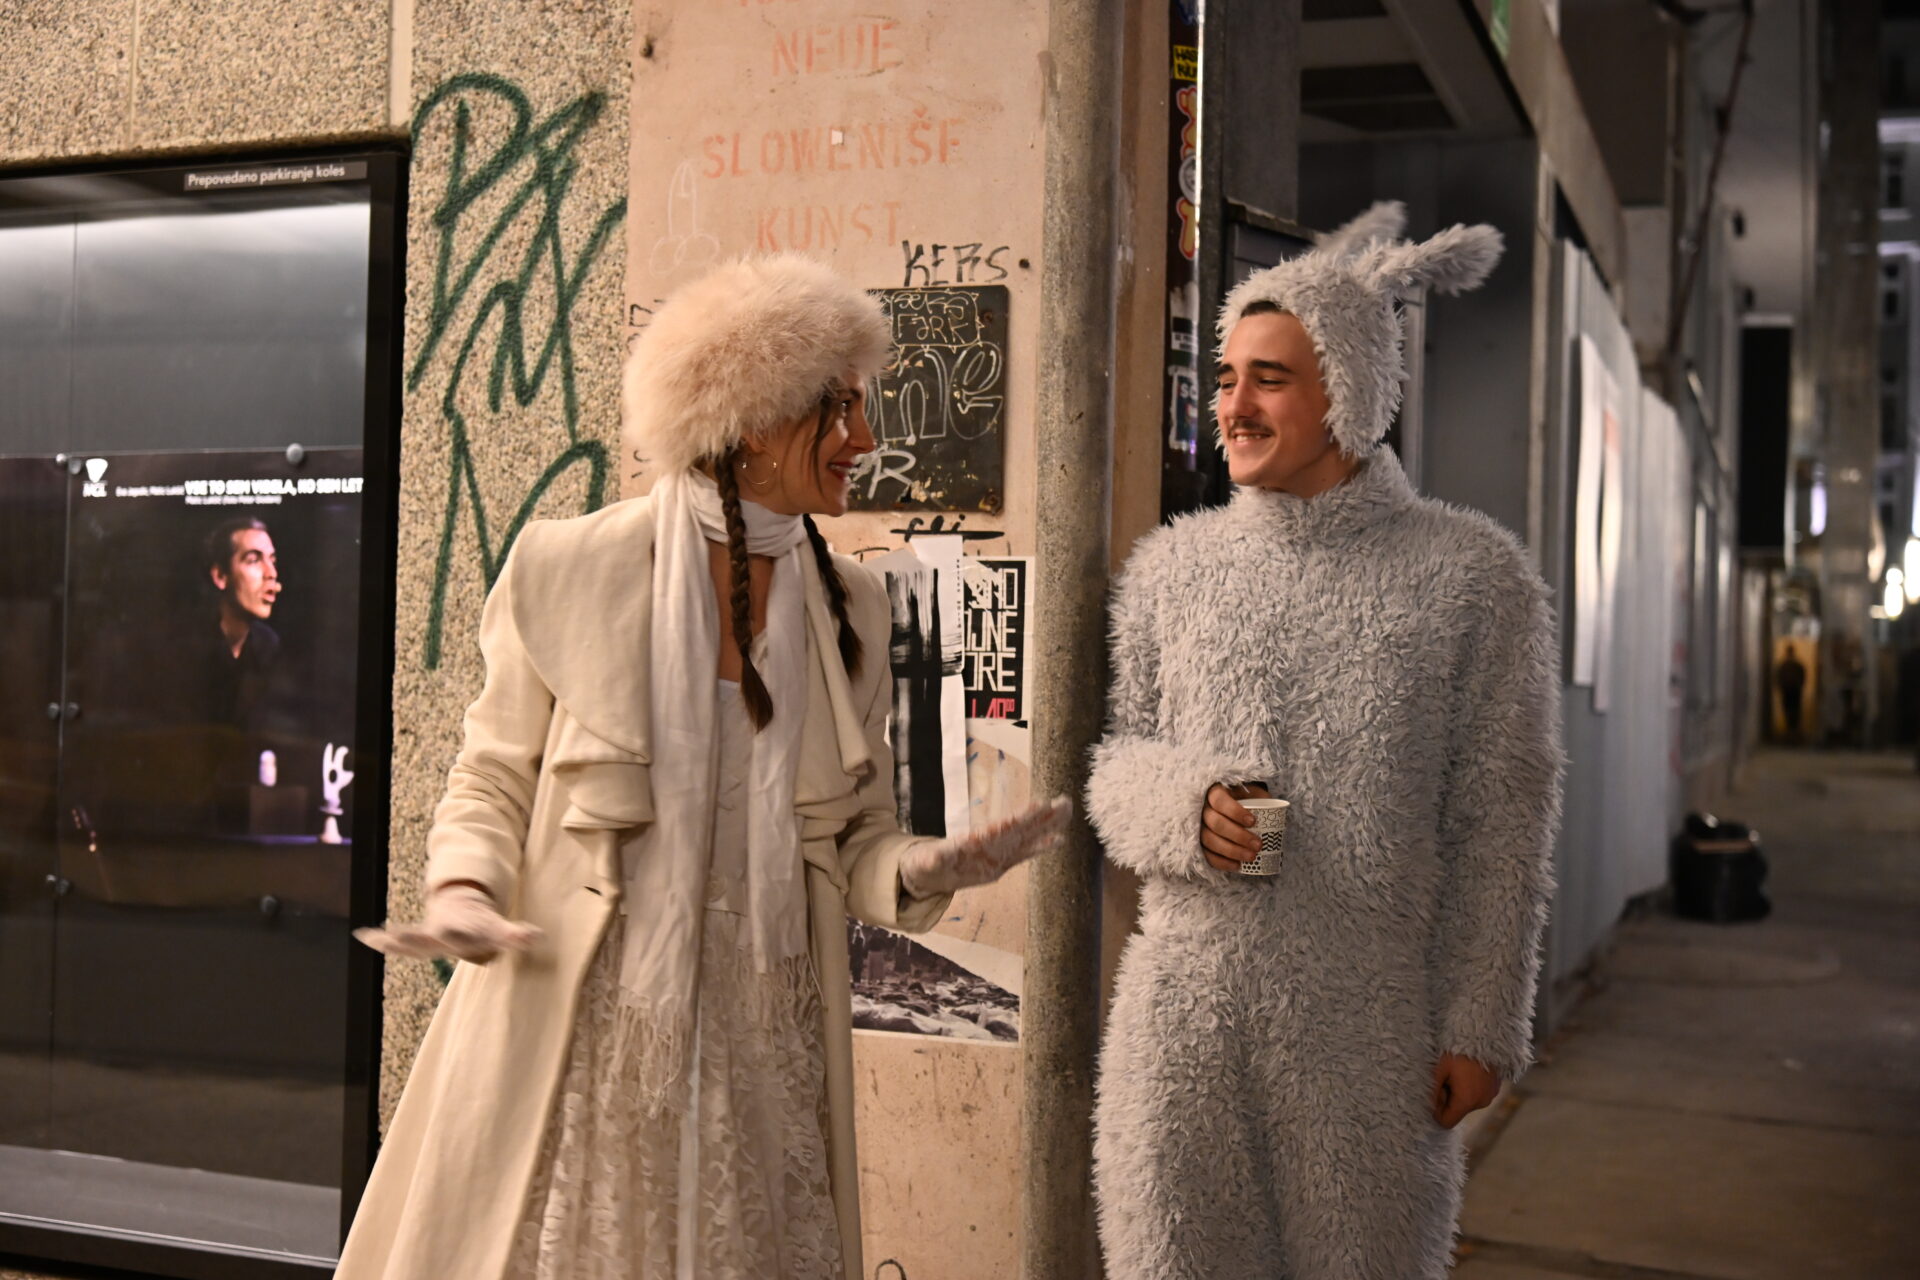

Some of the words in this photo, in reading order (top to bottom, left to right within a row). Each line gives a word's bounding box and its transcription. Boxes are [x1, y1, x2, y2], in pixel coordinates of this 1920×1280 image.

[187, 171, 258, 189] Prepovedano
[259, 166, 314, 186] parkiranje
[315, 164, 346, 178] koles
[757, 201, 902, 252] KUNST
